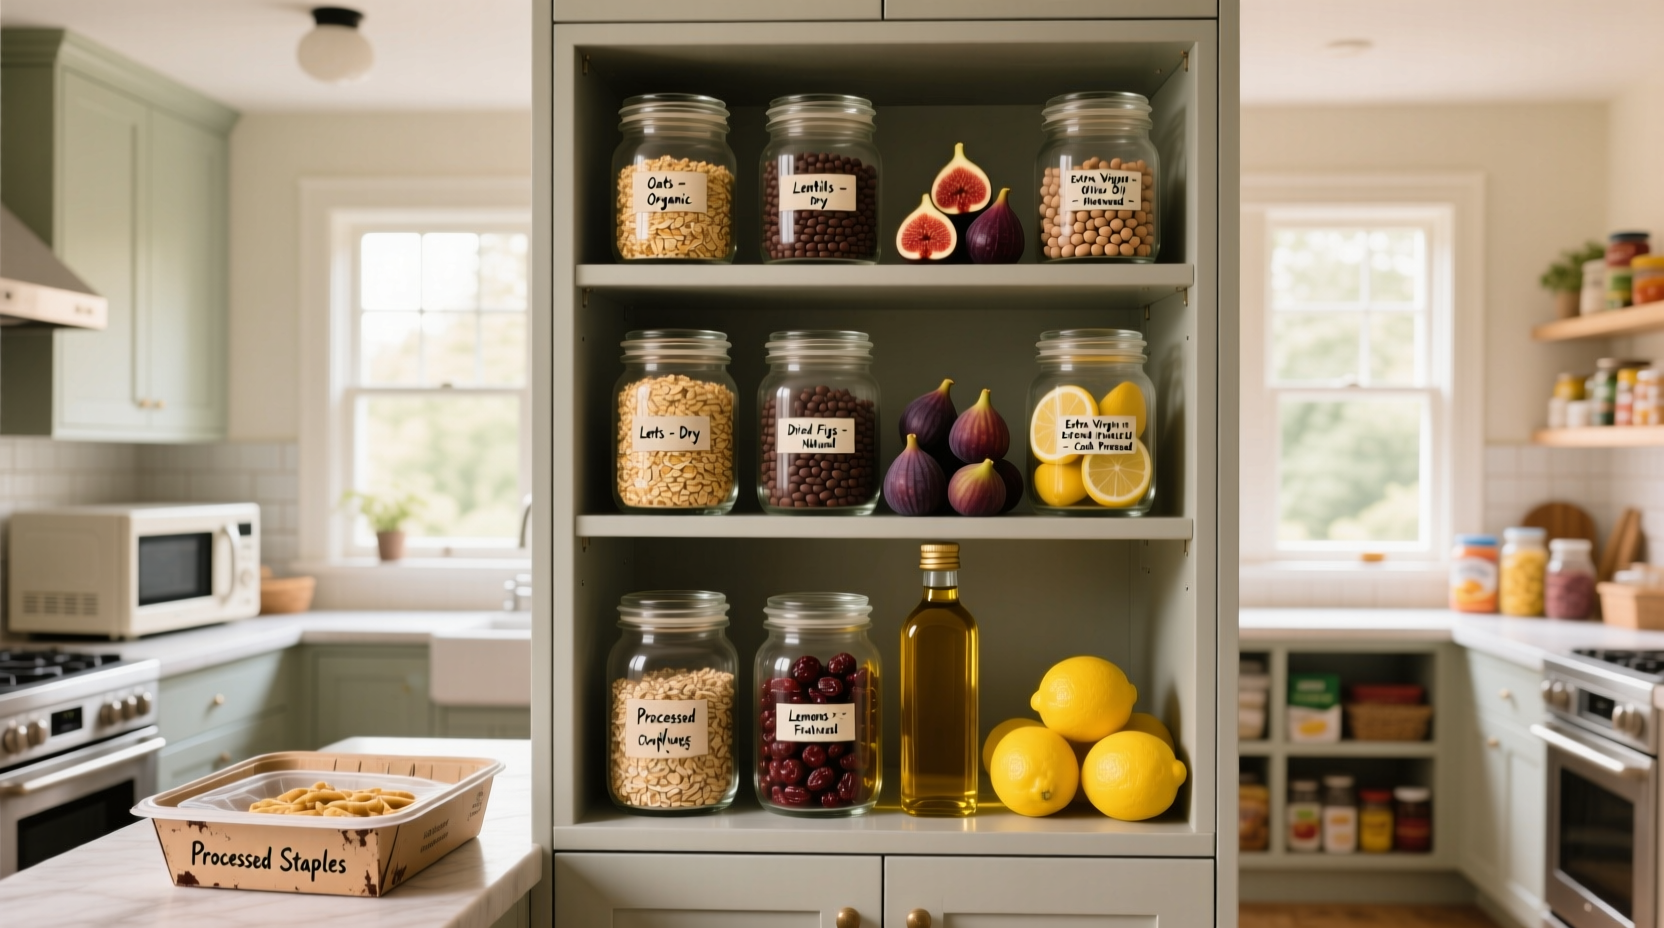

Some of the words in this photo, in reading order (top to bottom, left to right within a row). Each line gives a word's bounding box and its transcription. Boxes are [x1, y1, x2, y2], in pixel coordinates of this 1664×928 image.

[647, 176, 674, 189] Oats
[793, 179, 834, 194] Lentils
[647, 192, 692, 211] Organic
[810, 195, 828, 210] Dry
[679, 425, 700, 445] Dry
[637, 707, 696, 725] Processed
[191, 840, 272, 870] Processed
[280, 846, 347, 882] Staples
